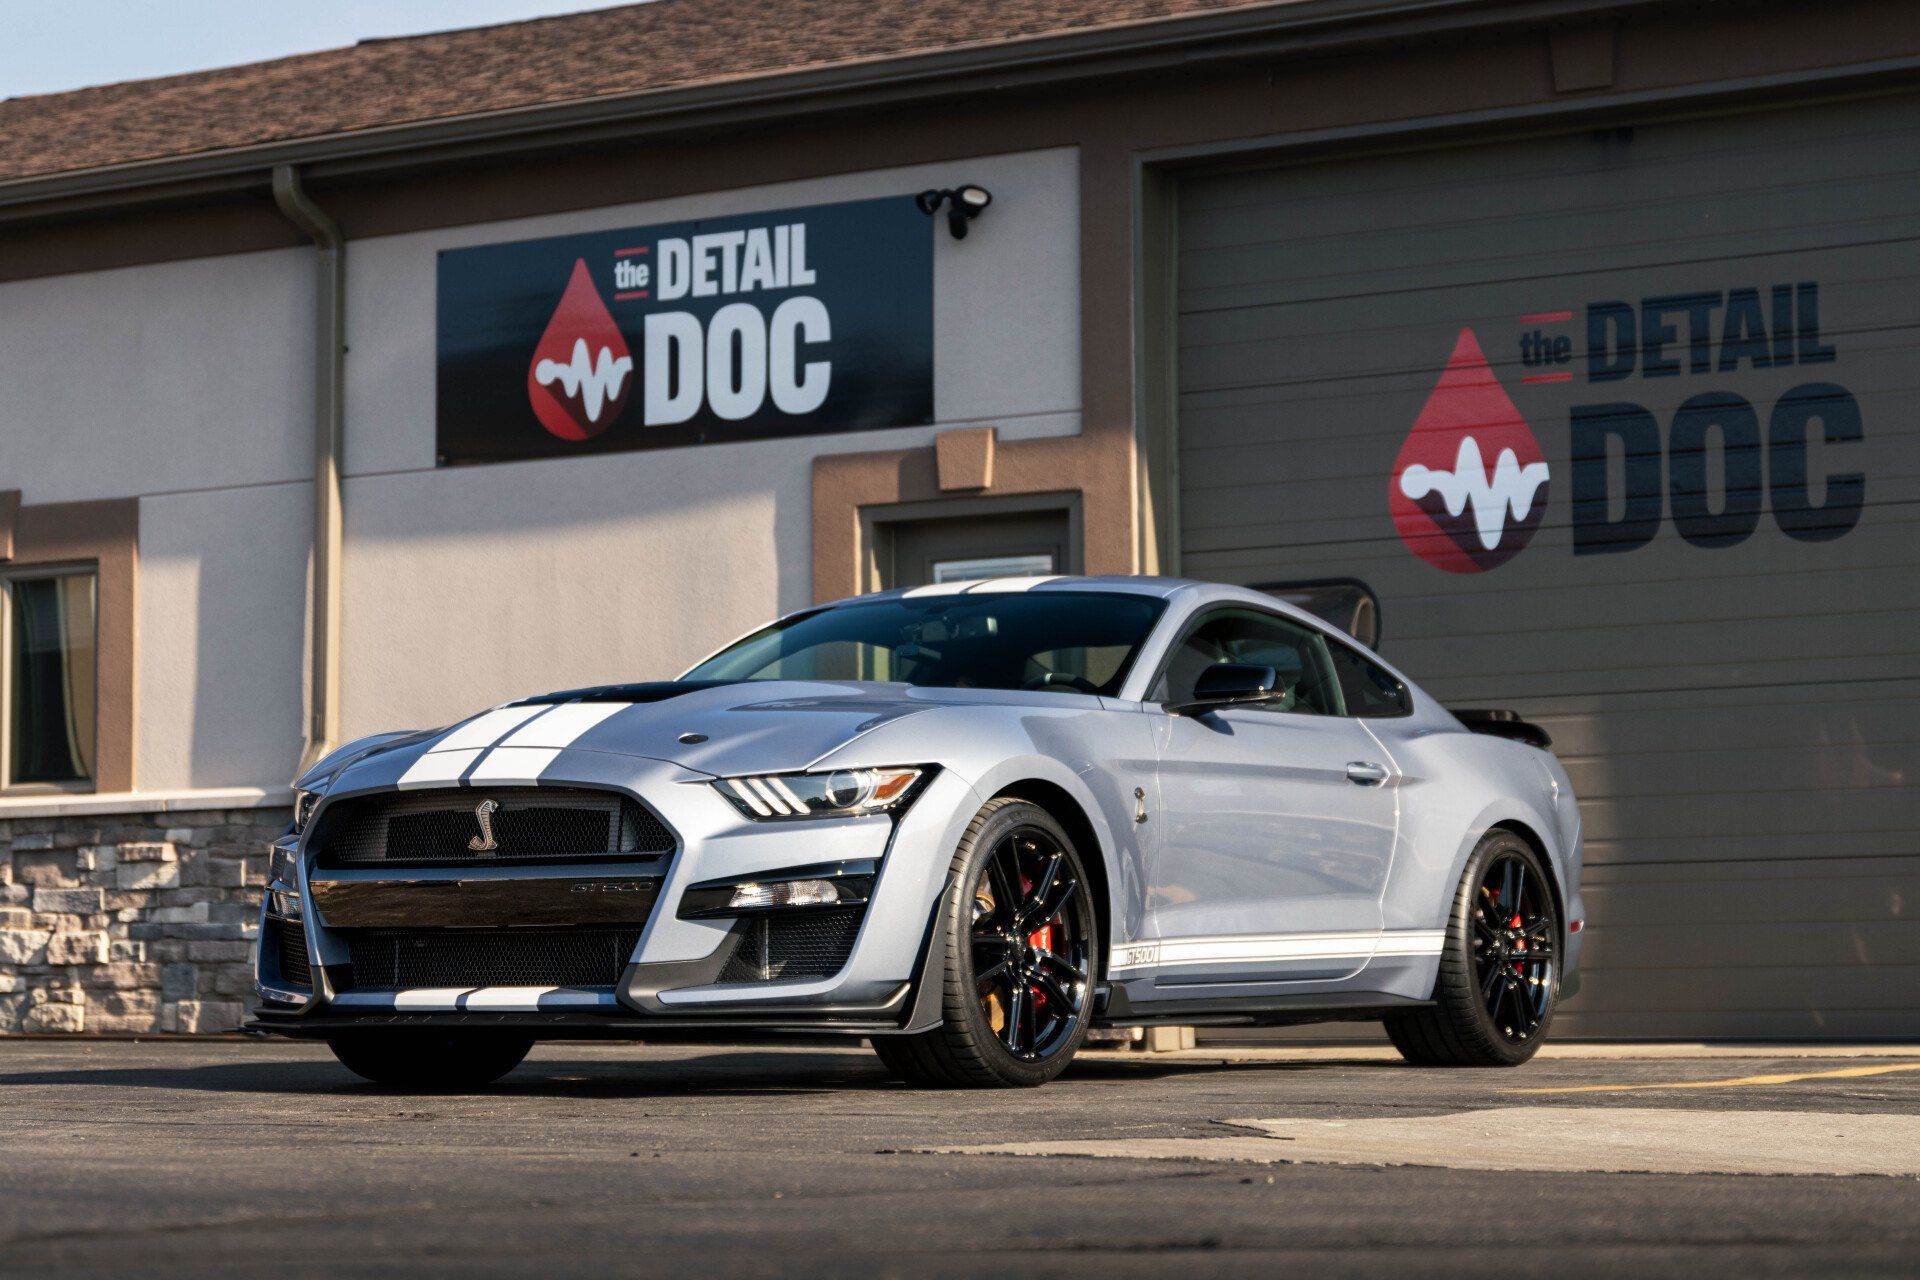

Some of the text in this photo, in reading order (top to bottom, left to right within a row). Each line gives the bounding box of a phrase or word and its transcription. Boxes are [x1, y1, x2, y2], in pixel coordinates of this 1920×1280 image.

[614, 223, 816, 300] the DETAIL
[644, 296, 832, 426] DOC
[1519, 281, 1837, 384] the DETAIL
[1570, 381, 1866, 557] DOC
